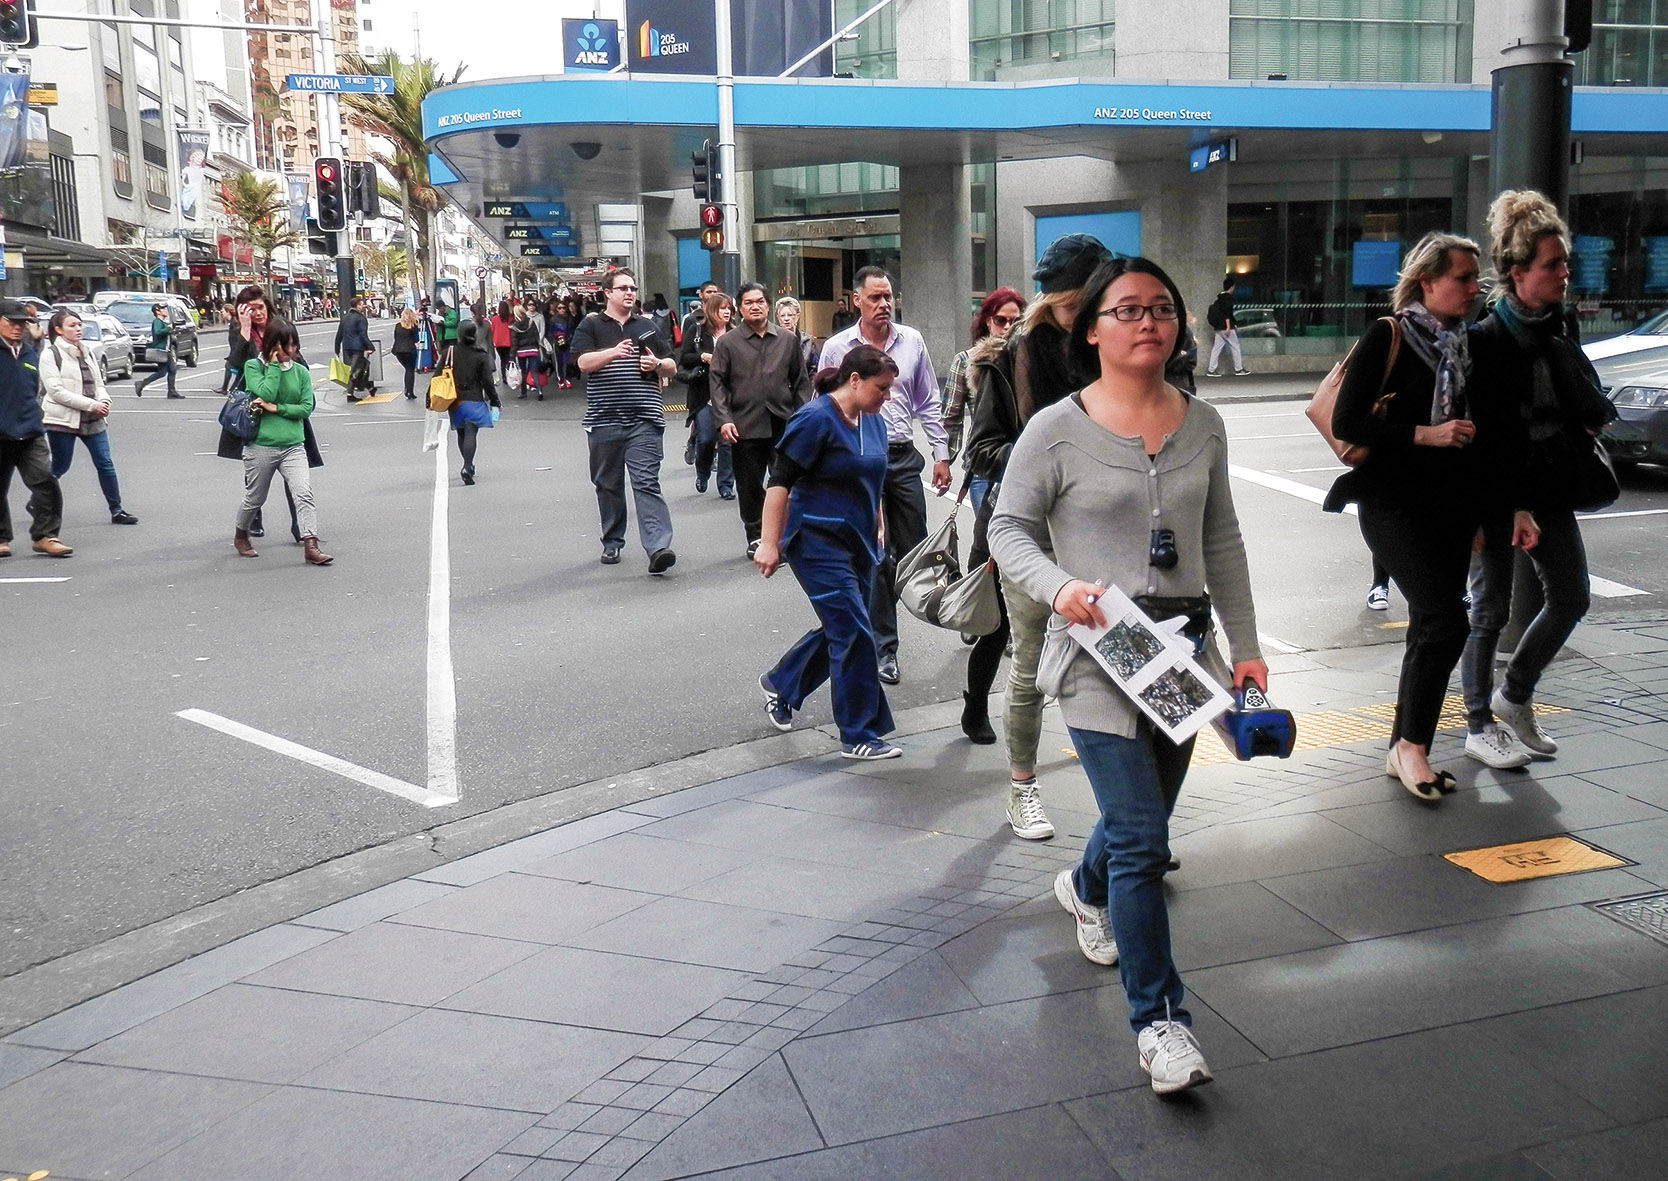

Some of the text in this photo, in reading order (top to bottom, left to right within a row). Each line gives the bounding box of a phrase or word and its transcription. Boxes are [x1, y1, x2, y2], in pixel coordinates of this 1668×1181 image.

[660, 33, 676, 44] 205
[660, 42, 690, 56] QUEEN
[574, 51, 609, 64] ANZ
[294, 76, 341, 90] VICTORIA
[437, 108, 522, 128] ANZ 205 Queen Street
[1094, 107, 1212, 120] ANZ 205 Queen Street
[489, 206, 512, 215] ANZ
